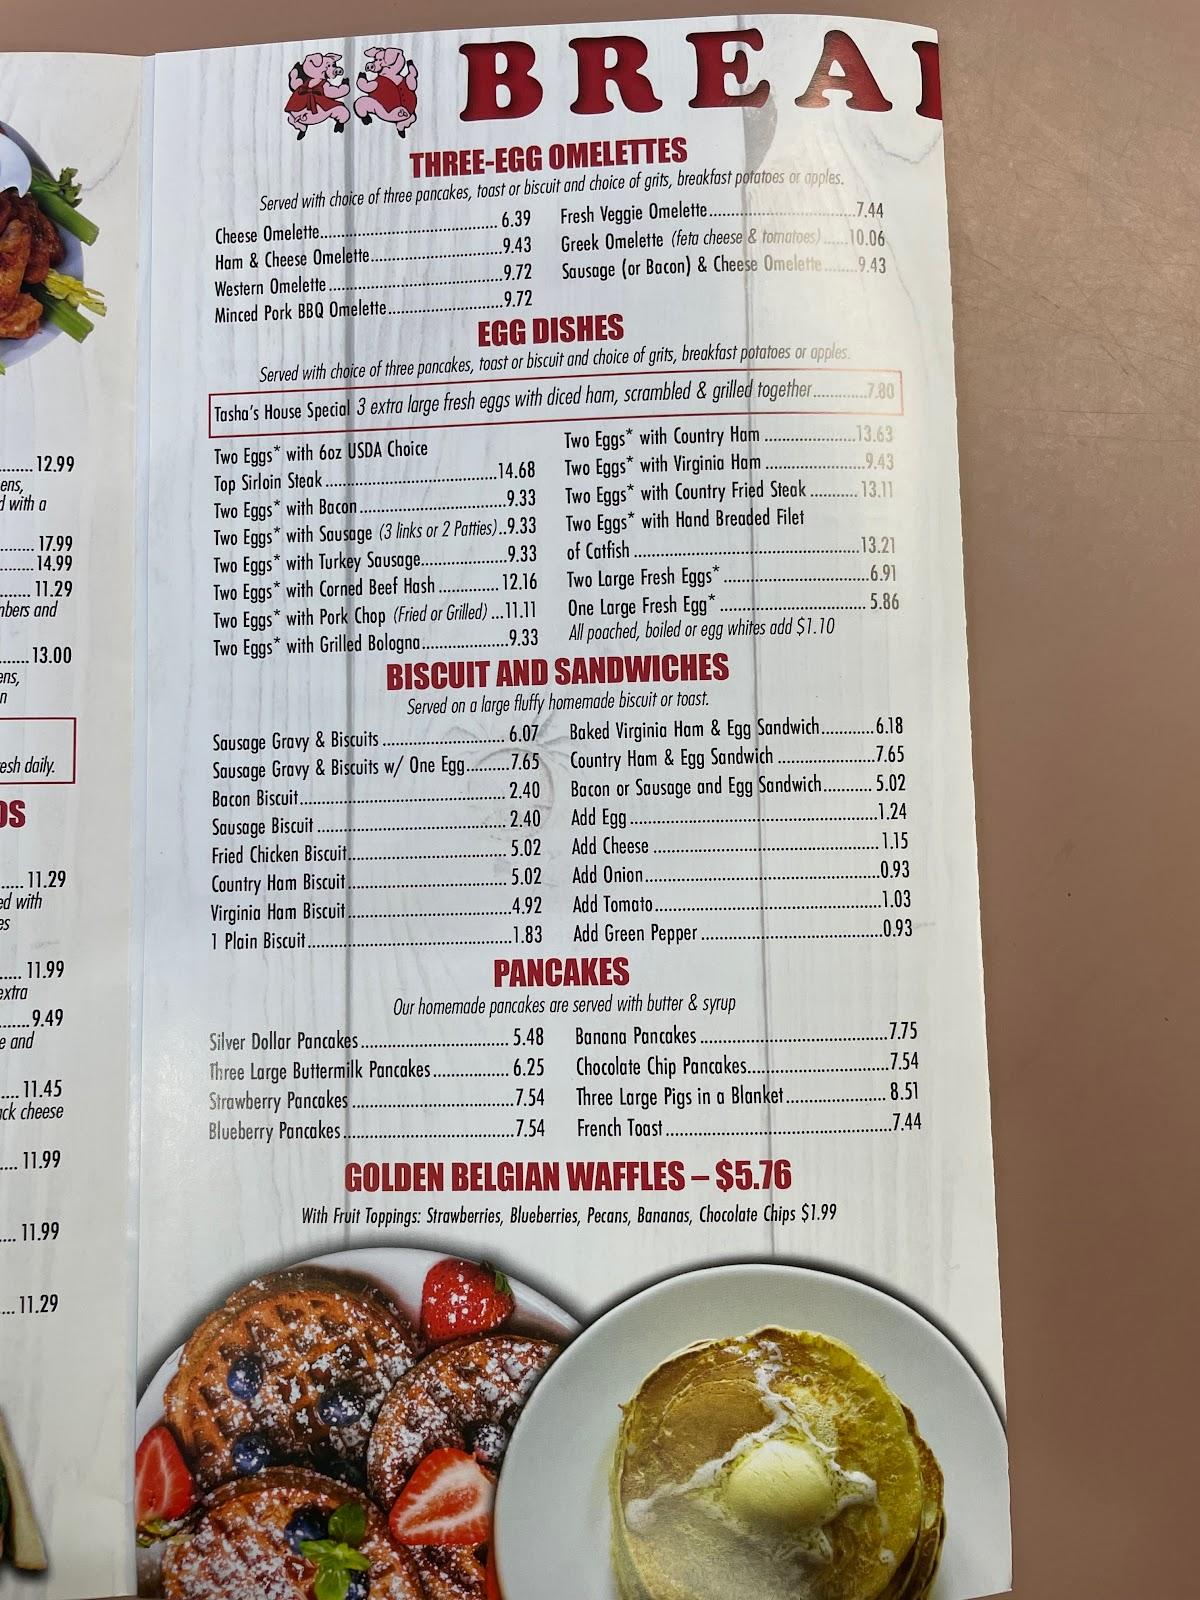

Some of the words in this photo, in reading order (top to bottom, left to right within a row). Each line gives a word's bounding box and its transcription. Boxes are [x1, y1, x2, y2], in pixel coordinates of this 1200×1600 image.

[409, 145, 542, 178] THREE-EGG
[549, 137, 687, 170] OMELETTES
[260, 193, 298, 211] Served
[302, 191, 325, 208] with
[330, 190, 364, 206] choice
[368, 187, 381, 204] of
[384, 187, 412, 203] three
[415, 185, 471, 205] pancakes,
[477, 183, 506, 198] toast
[509, 185, 521, 196] or
[524, 179, 561, 195] biscuit
[564, 175, 586, 192] and
[590, 174, 625, 190] choice
[629, 171, 642, 188] of
[645, 172, 672, 191] grits,
[677, 168, 732, 186] breakfast
[735, 168, 784, 189] potatoes
[789, 172, 801, 184] or
[804, 168, 844, 188] apples.
[561, 206, 594, 224] Fresh
[600, 205, 642, 225] Veggie
[649, 201, 707, 219] Omelette
[857, 202, 883, 218] 7.44
[216, 227, 257, 244] Cheese
[264, 223, 319, 241] Omelette
[502, 210, 530, 227] 6.39
[216, 255, 243, 270] Ham
[250, 252, 258, 268] &
[265, 250, 307, 268] Cheese
[313, 245, 369, 265] Omelette
[503, 236, 531, 253] 9.43
[215, 281, 263, 296] Western
[270, 276, 326, 294] Omelette
[504, 263, 531, 280] 9.72
[215, 304, 257, 323] Minced
[265, 303, 292, 320] Pork
[299, 302, 323, 319] BBQ
[330, 298, 386, 320] Omelette
[505, 290, 532, 307] 9.72
[478, 319, 526, 347] EGG
[533, 314, 624, 344] DISHES
[37, 456, 74, 472] 12.99
[214, 476, 235, 495] Top
[242, 473, 281, 490] Sirloin
[288, 470, 322, 488] Steak
[499, 461, 535, 479] 14.68
[10, 495, 34, 511] with
[39, 500, 46, 511] a
[39, 536, 72, 551] 17.99
[567, 541, 580, 560] of
[586, 540, 629, 559] Catfish
[861, 536, 894, 553] 13.21
[37, 555, 72, 571] 14.99
[36, 581, 72, 597] 11.29
[34, 600, 58, 617] and
[569, 623, 584, 640] All
[587, 621, 639, 644] poached,
[646, 620, 681, 638] boiled
[685, 625, 697, 637] or
[701, 624, 723, 640] egg
[728, 615, 766, 637] whites
[770, 617, 793, 635] add
[797, 617, 834, 636] $1.10
[33, 647, 71, 663] 13.00
[387, 661, 490, 690] BISCUIT
[496, 659, 548, 687] AND
[555, 653, 729, 685] SANDWICHES
[407, 696, 448, 715] Served
[452, 702, 465, 713] on
[470, 701, 477, 712] a
[481, 695, 509, 716] large
[514, 693, 545, 715] fluffy
[549, 691, 615, 710] homemade
[619, 690, 657, 708] biscuit
[661, 695, 673, 706] or
[677, 692, 708, 706] toast.
[213, 734, 265, 754] Sausage
[273, 732, 309, 752] Gravy
[316, 731, 325, 747] &
[332, 731, 378, 750] Biscuits
[510, 725, 539, 742] 6.07
[25, 756, 54, 776] daily.
[571, 751, 621, 771] Country
[628, 750, 657, 767] Ham
[665, 749, 674, 765] &
[681, 749, 704, 769] Egg
[711, 745, 773, 765] Sandwich
[876, 745, 904, 762] 7.65
[212, 845, 243, 864] Fried
[250, 844, 298, 863] Chicken
[305, 845, 347, 861] Biscuit
[511, 839, 541, 856] 5.02
[572, 836, 596, 855] Add
[603, 836, 648, 854] Cheese
[883, 832, 908, 849] 1.15
[28, 871, 66, 888] 11.29
[17, 891, 42, 909] with
[211, 905, 260, 925] Virginia
[268, 903, 296, 920] Ham
[304, 902, 345, 919] Biscuit
[512, 896, 541, 914] 4.92
[574, 923, 598, 942] Add
[605, 924, 644, 942] Green
[651, 924, 697, 945] Pepper
[884, 919, 912, 937] 0.93
[28, 961, 64, 978] 11.99
[494, 957, 629, 987] PANCAKES
[394, 998, 415, 1015] Our
[418, 996, 485, 1014] homemade
[489, 995, 545, 1017] pancakes
[550, 1001, 568, 1012] are
[573, 994, 613, 1012] served
[618, 993, 642, 1011] with
[647, 993, 683, 1011] butter
[688, 994, 697, 1010] &
[703, 998, 735, 1015] syrup
[33, 1009, 63, 1027] 9.49
[10, 1031, 35, 1049] and
[210, 1061, 244, 1080] Three
[251, 1063, 286, 1084] Large
[294, 1059, 362, 1079] Buttermilk
[370, 1058, 430, 1078] Pancakes
[514, 1058, 544, 1076] 6.25
[577, 1056, 640, 1075] Chocolate
[648, 1055, 676, 1079] Chip
[683, 1055, 746, 1074] Pancakes
[891, 1052, 918, 1070] 7.54
[24, 1080, 62, 1097] 11.45
[21, 1101, 63, 1119] cheese
[578, 1117, 621, 1137] French
[627, 1118, 662, 1136] Toast
[893, 1112, 921, 1131] 7.44
[24, 1150, 60, 1169] 11.99
[345, 1163, 443, 1192] GOLDEN
[452, 1162, 559, 1191] BELGIAN
[566, 1161, 685, 1191] WAFFLES
[716, 1159, 791, 1192] $5.76
[303, 1206, 327, 1223] With
[334, 1208, 360, 1223] Fruit
[366, 1207, 421, 1227] Toppings:
[427, 1205, 503, 1226] Strawberries,
[510, 1205, 580, 1226] Blueberries,
[587, 1207, 630, 1226] Pecans,
[638, 1207, 692, 1225] Bananas,
[700, 1204, 757, 1222] Chocolate
[764, 1203, 795, 1224] Chips
[802, 1203, 836, 1223] $1.99
[22, 1222, 59, 1241] 11.99
[20, 1294, 58, 1313] 11.29
